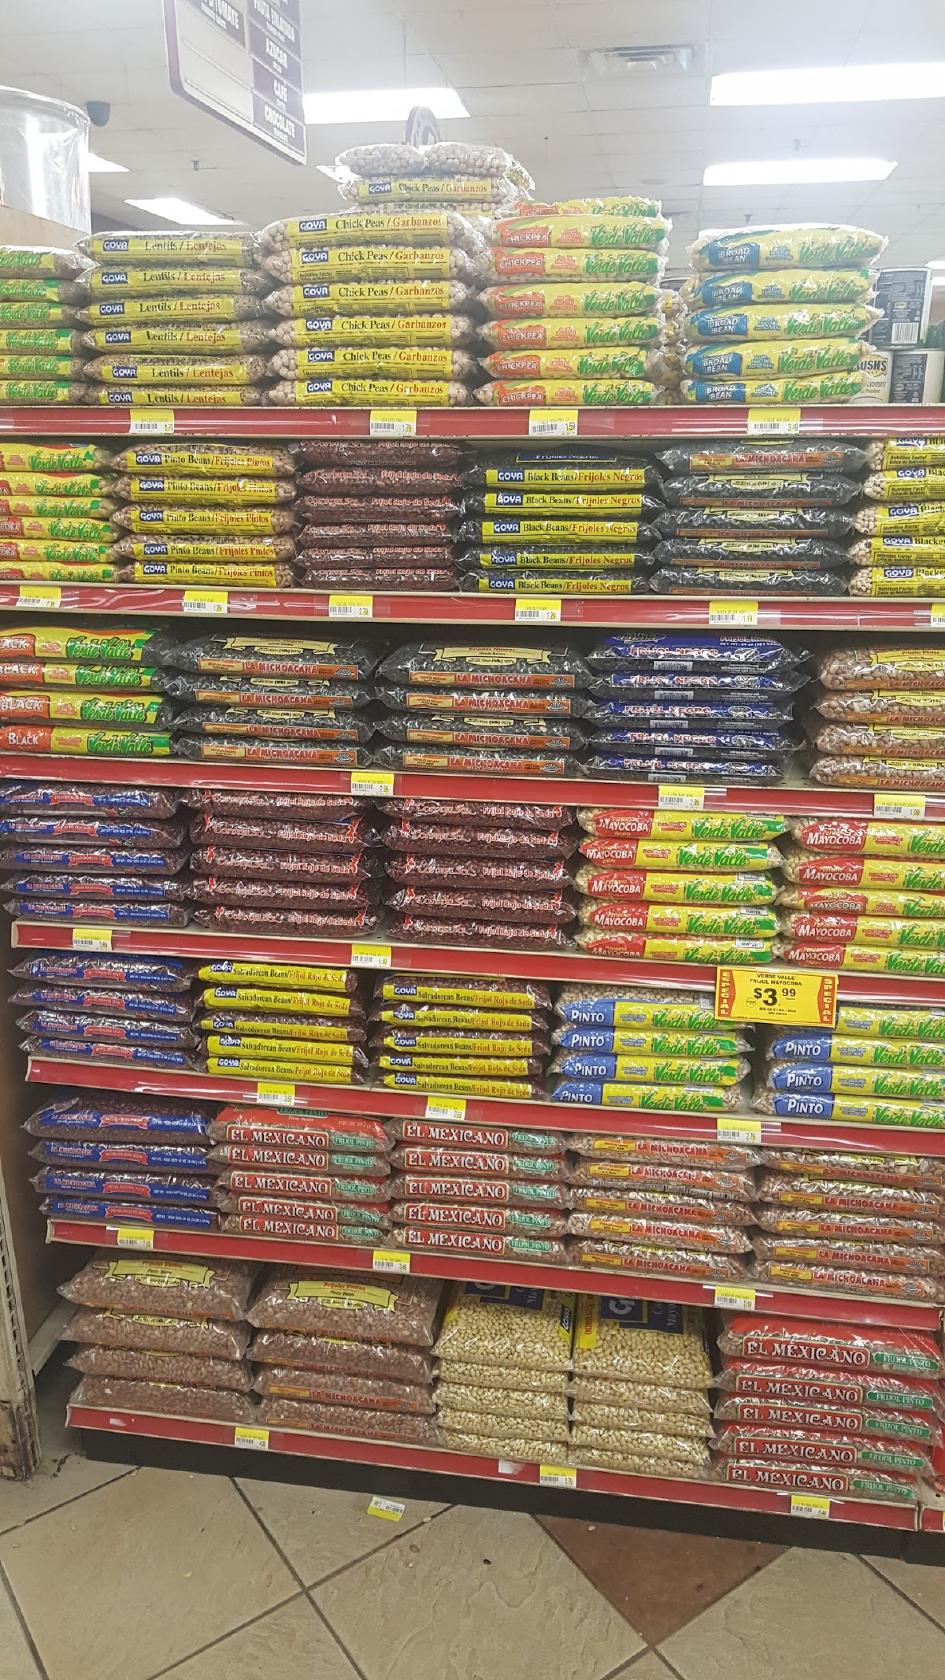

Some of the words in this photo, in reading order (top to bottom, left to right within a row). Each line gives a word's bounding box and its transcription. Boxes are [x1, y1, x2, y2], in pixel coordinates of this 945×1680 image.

[264, 104, 295, 137] CHOCOLATE
[302, 252, 328, 262] GOYA
[338, 252, 365, 262] Chick
[368, 251, 388, 261] Peas
[395, 251, 444, 261] Garbanzos
[499, 258, 541, 268] CHICKPEA
[100, 304, 123, 313] GOYA
[140, 302, 171, 312] Lentils
[180, 302, 220, 312] Lentejas
[306, 320, 332, 330] GOYA
[342, 320, 367, 330] Chick
[371, 321, 390, 329] Peas
[398, 320, 446, 329] Garbanzos
[709, 319, 737, 327] BROAD
[712, 325, 734, 334] BEAN
[787, 319, 822, 336] Verde
[501, 332, 542, 341] CHICKPEA
[308, 351, 334, 362] GOYA
[344, 352, 369, 362] Chick
[372, 352, 391, 360] Peas
[399, 353, 447, 362] Garbanzos
[703, 358, 731, 367] BROAD
[780, 352, 813, 371] Verde
[815, 347, 852, 368] Valle
[113, 367, 136, 377] GOYA
[152, 367, 183, 378] Lentils
[193, 369, 233, 379] Lentejas
[705, 364, 728, 372] BEAN
[136, 454, 161, 464] GOYA
[165, 455, 185, 463] Pinto
[528, 473, 549, 481] Black
[614, 474, 643, 482] Negros
[607, 525, 636, 534] Negros
[144, 565, 167, 574] GOYA
[170, 566, 189, 574] Pinto
[68, 638, 100, 658] Verde
[101, 638, 132, 658] Valle
[258, 664, 318, 674] MICHOACANA
[471, 675, 532, 684] MICHOACANA
[2, 698, 43, 710] BLACK
[8, 733, 39, 744] BLACK
[88, 732, 120, 754] Verde
[121, 732, 152, 754] Valle
[468, 734, 528, 744] MICHOACANA
[598, 819, 649, 832] MAYOCOBA
[694, 821, 728, 838] Verde
[731, 819, 764, 838] Valle
[807, 833, 861, 845] MAYOCOBA
[587, 849, 633, 859] MAYOCOBA
[679, 847, 711, 865] Verde
[714, 848, 747, 866] Valle
[803, 868, 858, 881] MAYOCOBA
[592, 881, 641, 894] MAYOCOBA
[685, 882, 719, 901] Verde
[721, 883, 754, 902] Valle
[798, 925, 851, 937] MAYOCOBA
[789, 950, 840, 962] MAYOCOBA
[782, 988, 796, 997] 99
[822, 979, 832, 1022] SPECIAL
[571, 1010, 604, 1023] PINTO
[571, 1034, 604, 1047] PINTO
[653, 1036, 686, 1054] Verde
[688, 1036, 719, 1055] Valle
[785, 1042, 821, 1057] PINTO
[873, 1046, 908, 1064] Verde
[910, 1046, 943, 1065] Valle
[574, 1063, 607, 1076] PINTO
[655, 1064, 688, 1081] Verde
[690, 1063, 721, 1083] Valle
[787, 1073, 822, 1087] PINTO
[874, 1078, 909, 1094] Verde
[911, 1077, 942, 1096] Valle
[787, 1099, 823, 1114] PINTO
[231, 1129, 248, 1141] EL
[251, 1133, 325, 1147] MEXICANO
[407, 1125, 425, 1137] EL
[428, 1127, 505, 1145] MEXICANO
[650, 1145, 708, 1156] MICHOACANA
[235, 1176, 251, 1188] EL
[254, 1178, 328, 1193] MEXICANO
[838, 1198, 897, 1210] MICHOACANA
[243, 1219, 260, 1231] EL
[264, 1221, 336, 1238] MEXICANO
[408, 1231, 424, 1243] EL
[428, 1233, 502, 1251] MEXICANO
[747, 1342, 768, 1355] EL
[772, 1343, 866, 1365] MEXICANO
[883, 1354, 907, 1365] FRIJOL
[908, 1357, 931, 1368] PINTO
[741, 1380, 763, 1392] EL
[767, 1382, 858, 1402] MEXICANO
[876, 1393, 899, 1402] FRIJOL
[901, 1396, 925, 1406] PINTO
[743, 1408, 764, 1419] EL
[768, 1410, 858, 1429] MEXICANO
[875, 1421, 898, 1431] FRIJOL
[900, 1423, 922, 1435] PINTO
[738, 1441, 759, 1454] EL
[763, 1443, 853, 1463] MEXICANO
[869, 1452, 893, 1463] FRIJOL
[894, 1456, 916, 1466] PINTO
[732, 1469, 751, 1481] EL
[755, 1471, 845, 1491] MEXICANO
